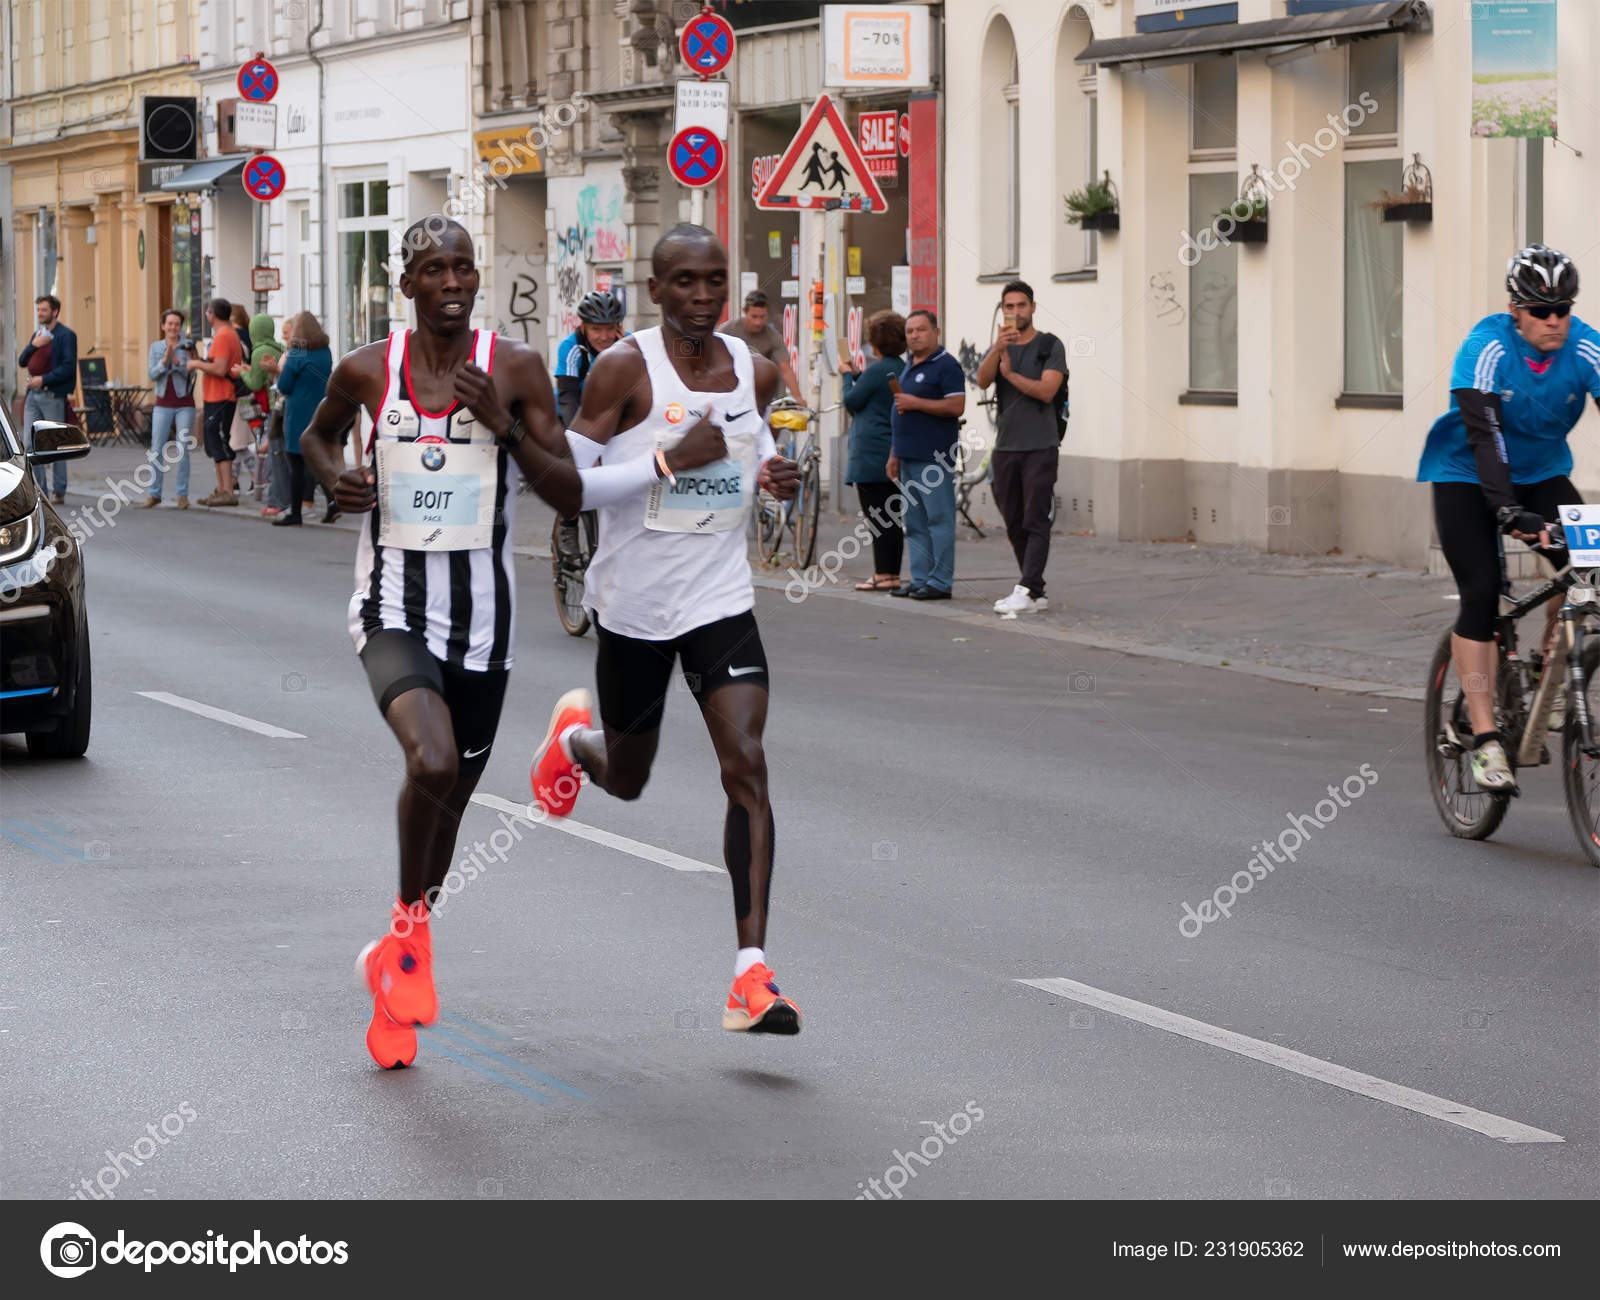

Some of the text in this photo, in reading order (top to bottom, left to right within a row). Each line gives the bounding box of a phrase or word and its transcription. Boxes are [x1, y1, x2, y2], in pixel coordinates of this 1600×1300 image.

[861, 117, 894, 151] SALE
[669, 475, 740, 496] KIPCHOGE
[413, 490, 454, 509] BOIT
